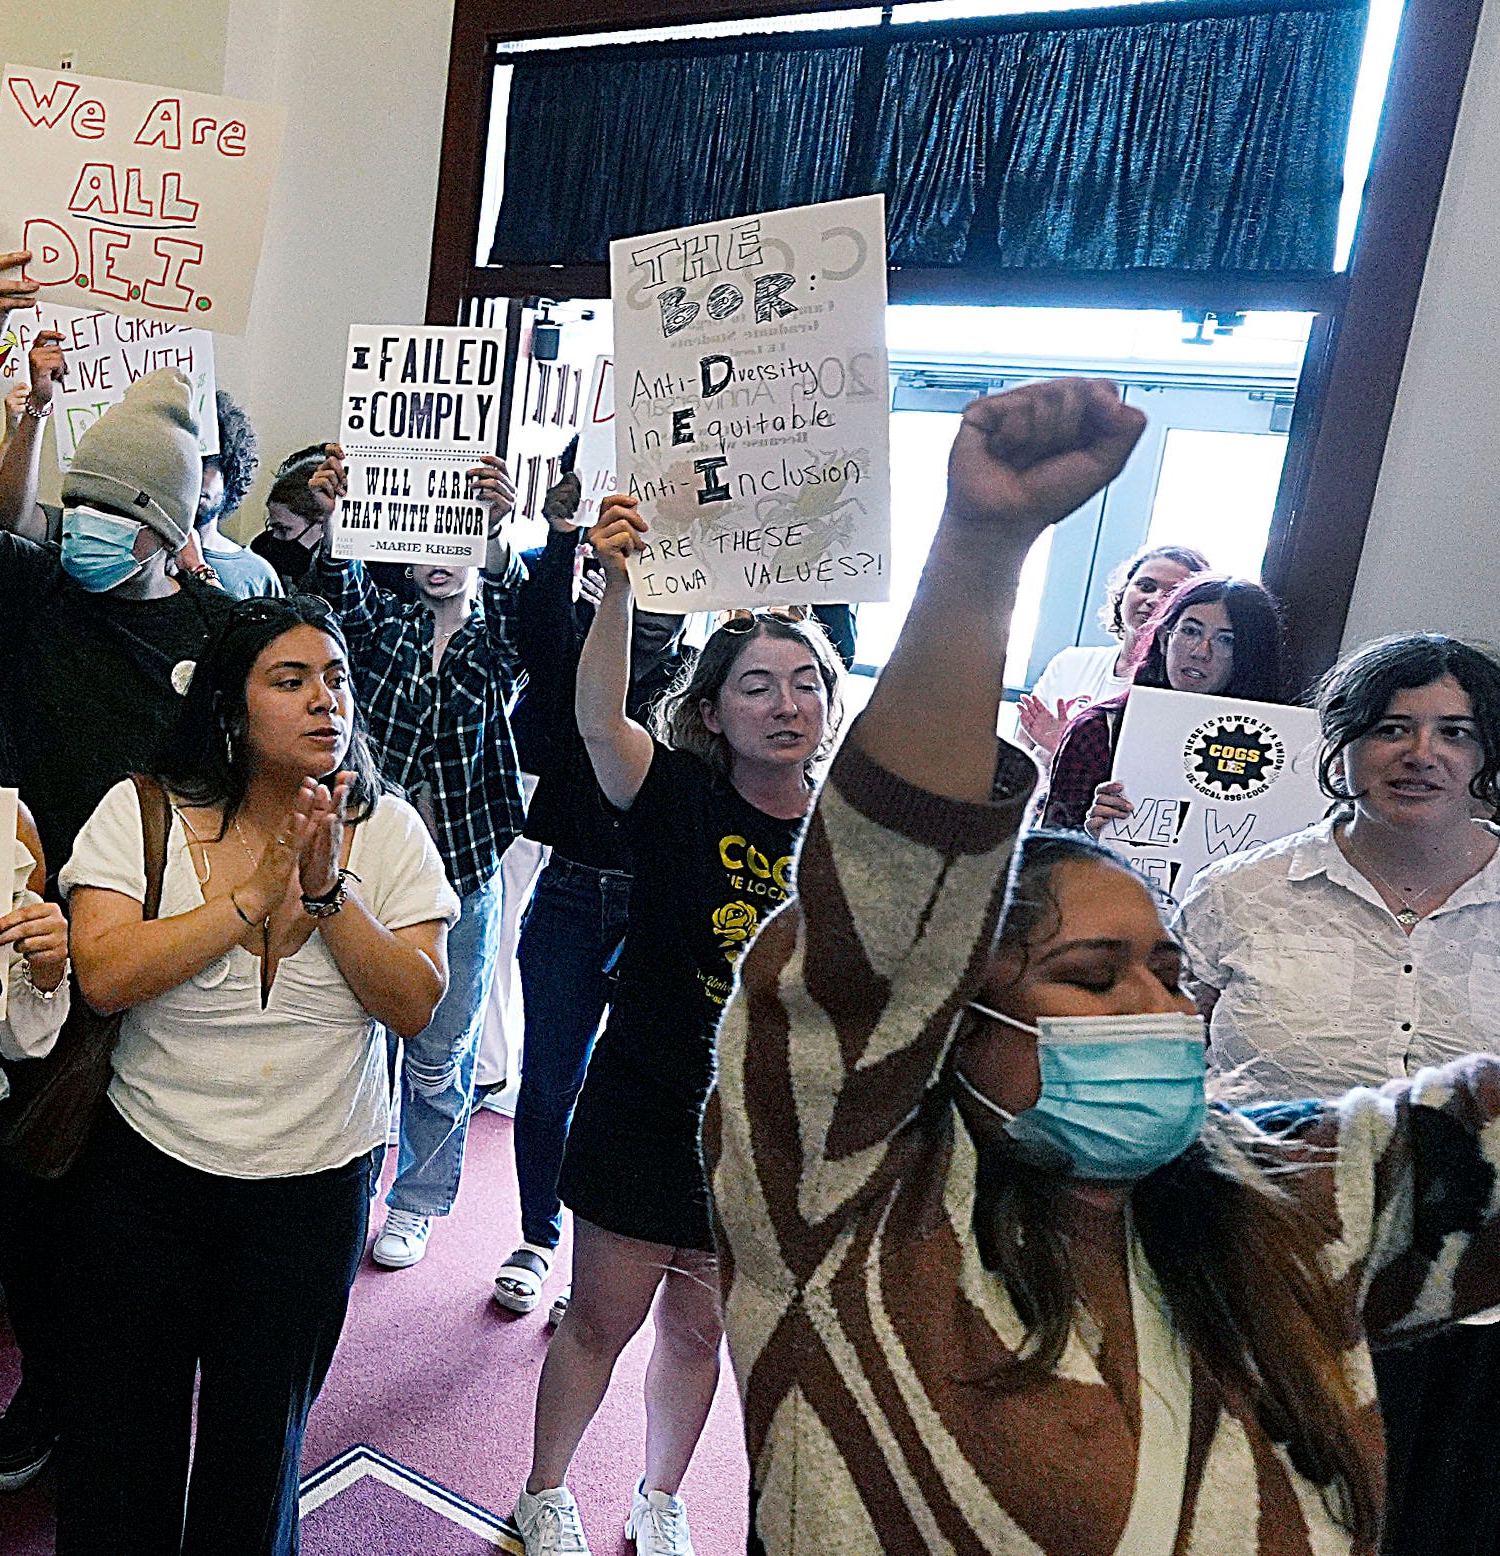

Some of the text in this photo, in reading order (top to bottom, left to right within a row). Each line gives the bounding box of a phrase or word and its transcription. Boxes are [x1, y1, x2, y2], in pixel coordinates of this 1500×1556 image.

[8, 77, 247, 157] We Are
[68, 163, 199, 222] ALL
[22, 219, 213, 313] D.E.I.
[631, 219, 763, 289] THE
[657, 273, 817, 338] BOR:
[61, 355, 113, 394] LIVE
[352, 336, 500, 386] I FAILED
[369, 391, 494, 443] COMPLY
[366, 466, 412, 497] WILL
[341, 500, 484, 536] THAT WITH HONOR
[425, 543, 473, 556] KREBS
[639, 522, 809, 565] ARE THESE
[643, 552, 883, 597] IOWA VALUES?!
[1184, 728, 1204, 757] THERE
[1203, 719, 1215, 729] IS
[1217, 715, 1258, 726] POWER
[1259, 723, 1272, 733] IN
[1274, 741, 1285, 771] UNION
[1209, 744, 1261, 763] COGS
[1185, 772, 1198, 785] UE
[1194, 782, 1221, 800] LOCAL
